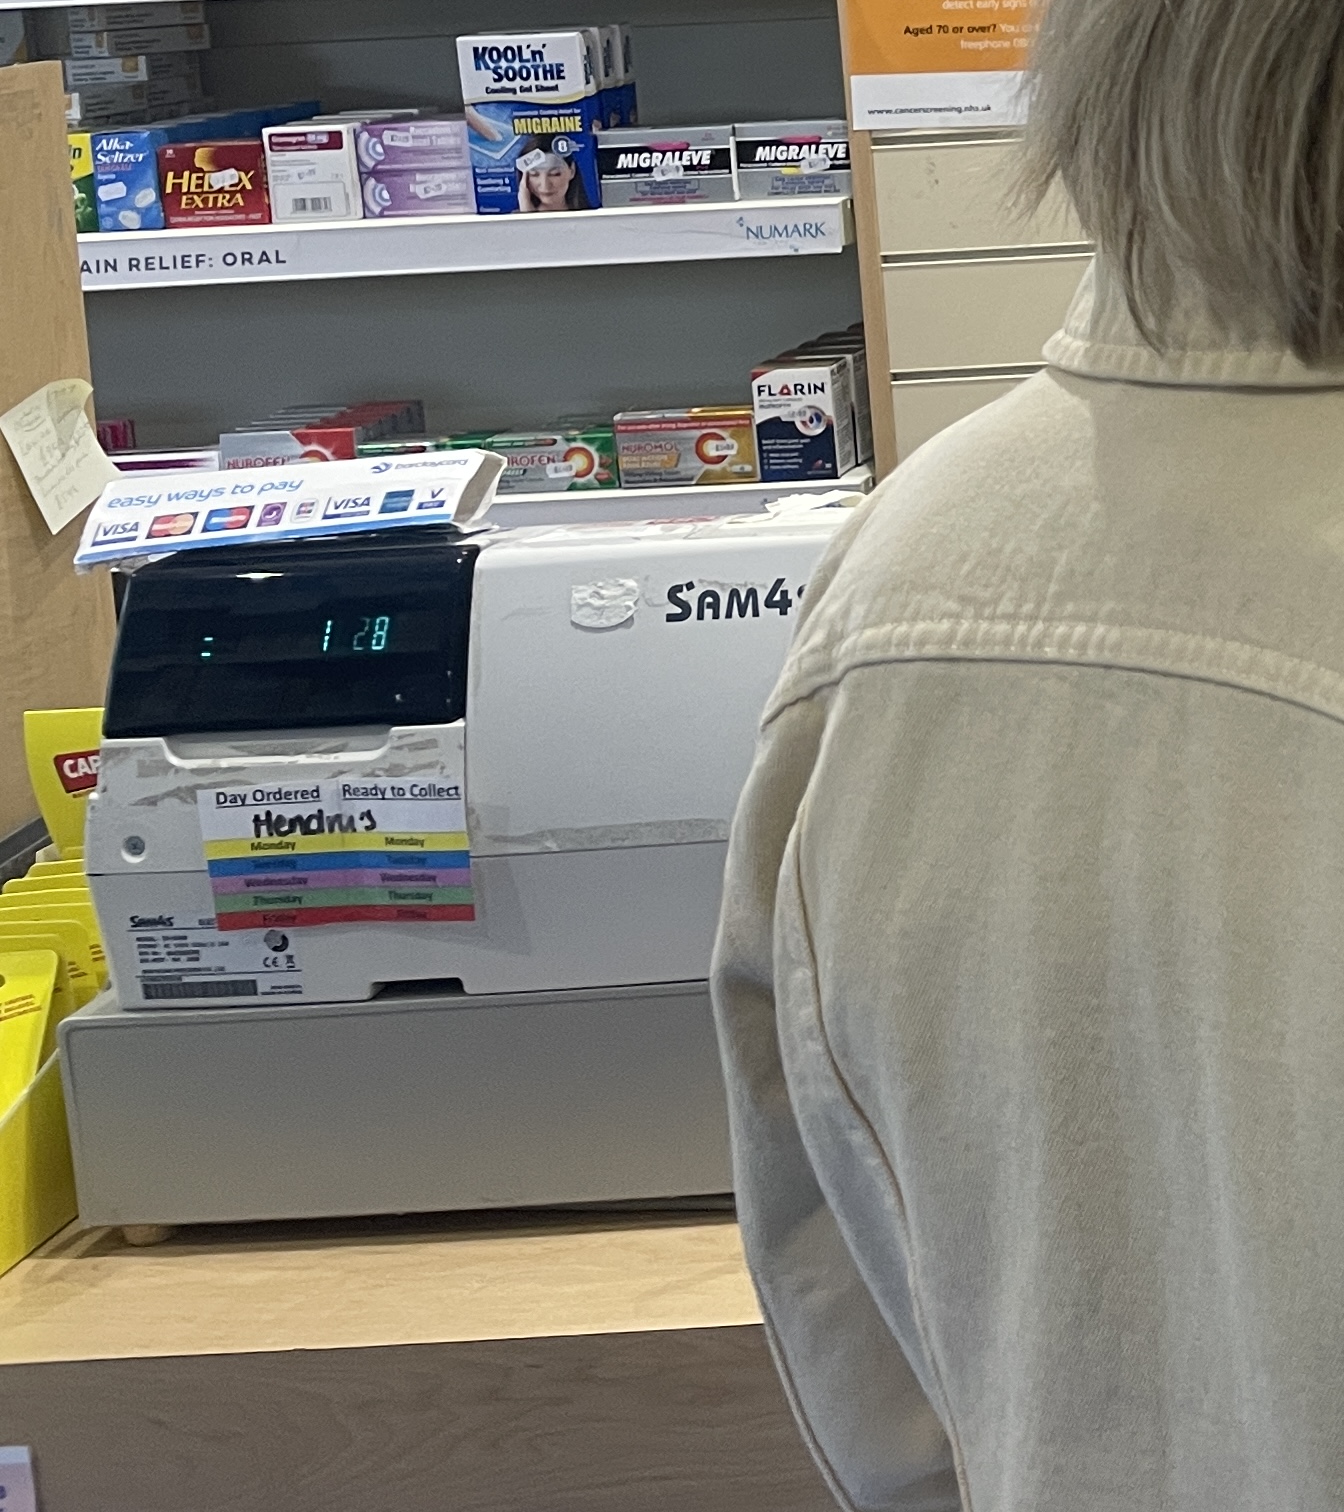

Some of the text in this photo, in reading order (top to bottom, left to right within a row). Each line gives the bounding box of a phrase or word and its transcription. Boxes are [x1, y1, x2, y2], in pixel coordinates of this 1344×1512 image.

[904, 23, 997, 37] Aged 70 or over?
[492, 62, 566, 83] SOOTHE
[514, 116, 583, 135] MIGRAINE
[95, 151, 147, 165] Seltzer
[617, 150, 711, 169] MIGRALEVE
[755, 144, 847, 162] MIGRALEVE
[181, 193, 245, 210] EXTRA
[746, 222, 826, 239] NUMARK
[80, 249, 287, 274] AIN RELIEF: ORAL
[757, 382, 825, 397] FLARIN
[621, 442, 679, 453] NUROMOL
[506, 454, 557, 467] ROFEN
[107, 479, 304, 508] easy ways to pay
[333, 496, 371, 510] VISA
[102, 521, 139, 537] VISA
[216, 786, 320, 806] Day Ordered
[342, 783, 460, 799] Ready to Collect
[250, 840, 296, 852] Monday
[384, 836, 425, 848] Monday
